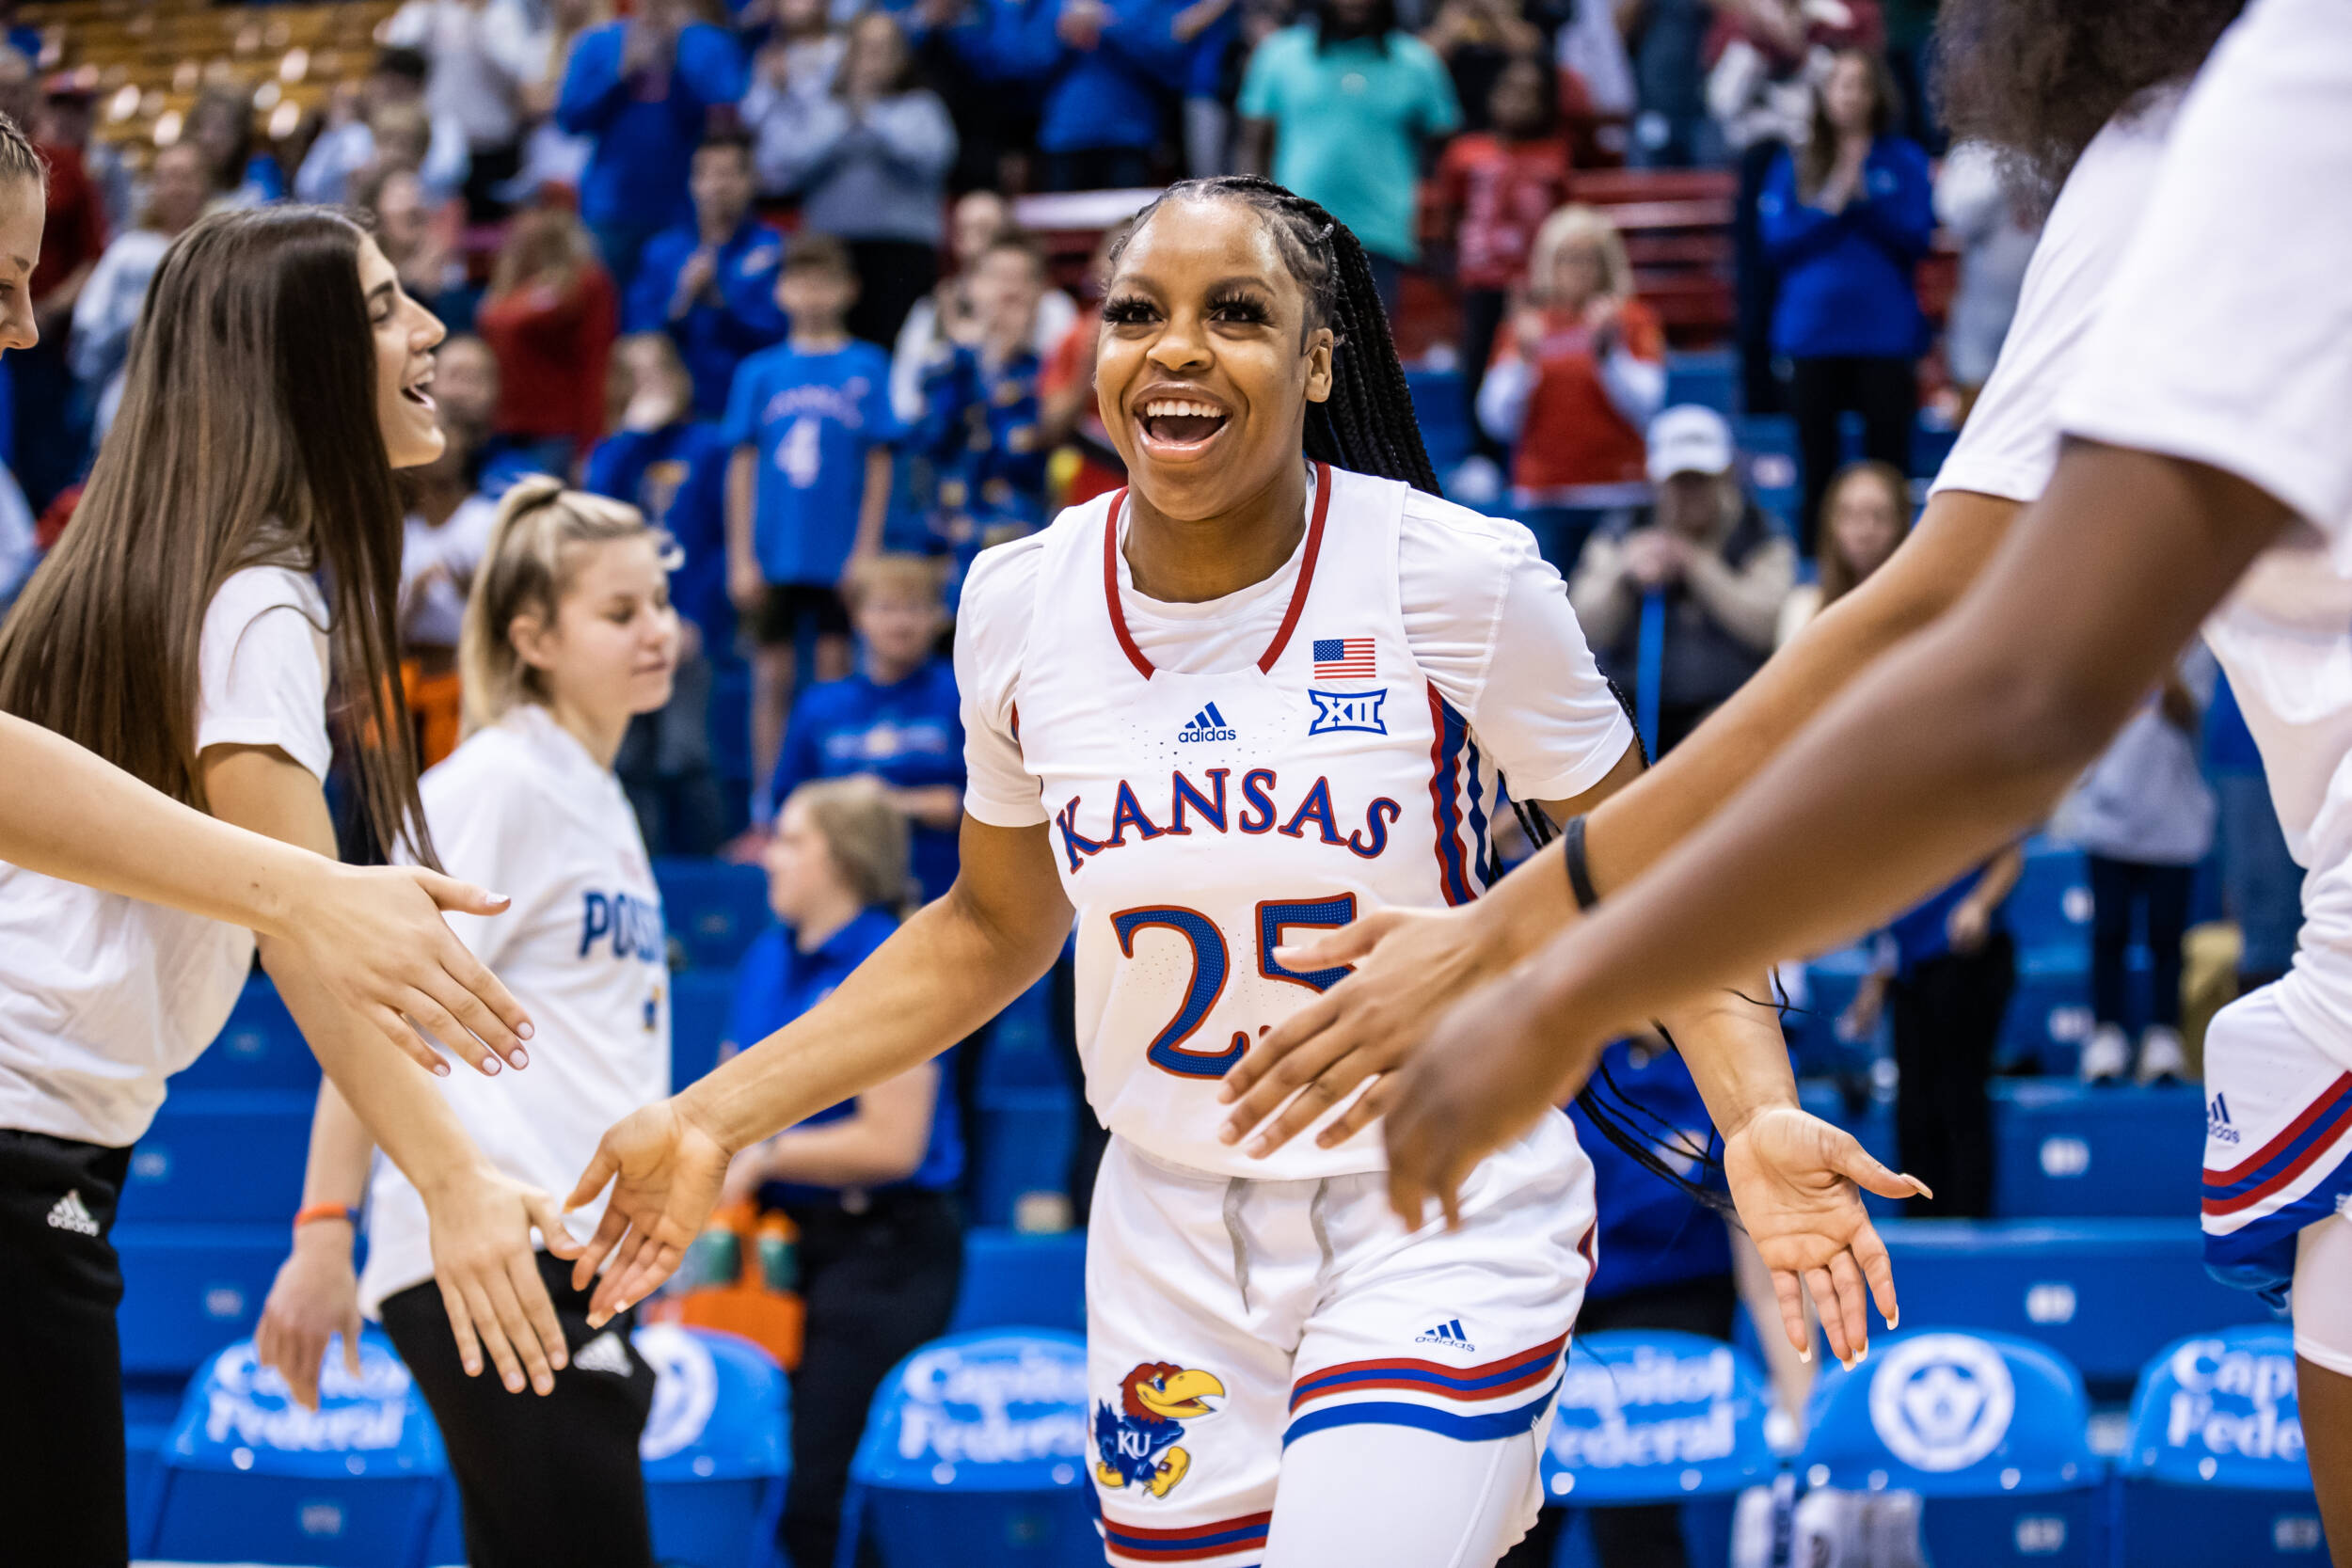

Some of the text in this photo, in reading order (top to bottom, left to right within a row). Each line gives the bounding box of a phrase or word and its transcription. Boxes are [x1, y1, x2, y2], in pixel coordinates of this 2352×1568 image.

[1178, 726, 1237, 743] adidas
[1055, 768, 1401, 874] KANSAS
[1415, 1336, 1475, 1353] adidas
[1117, 1429, 1152, 1460] KU
